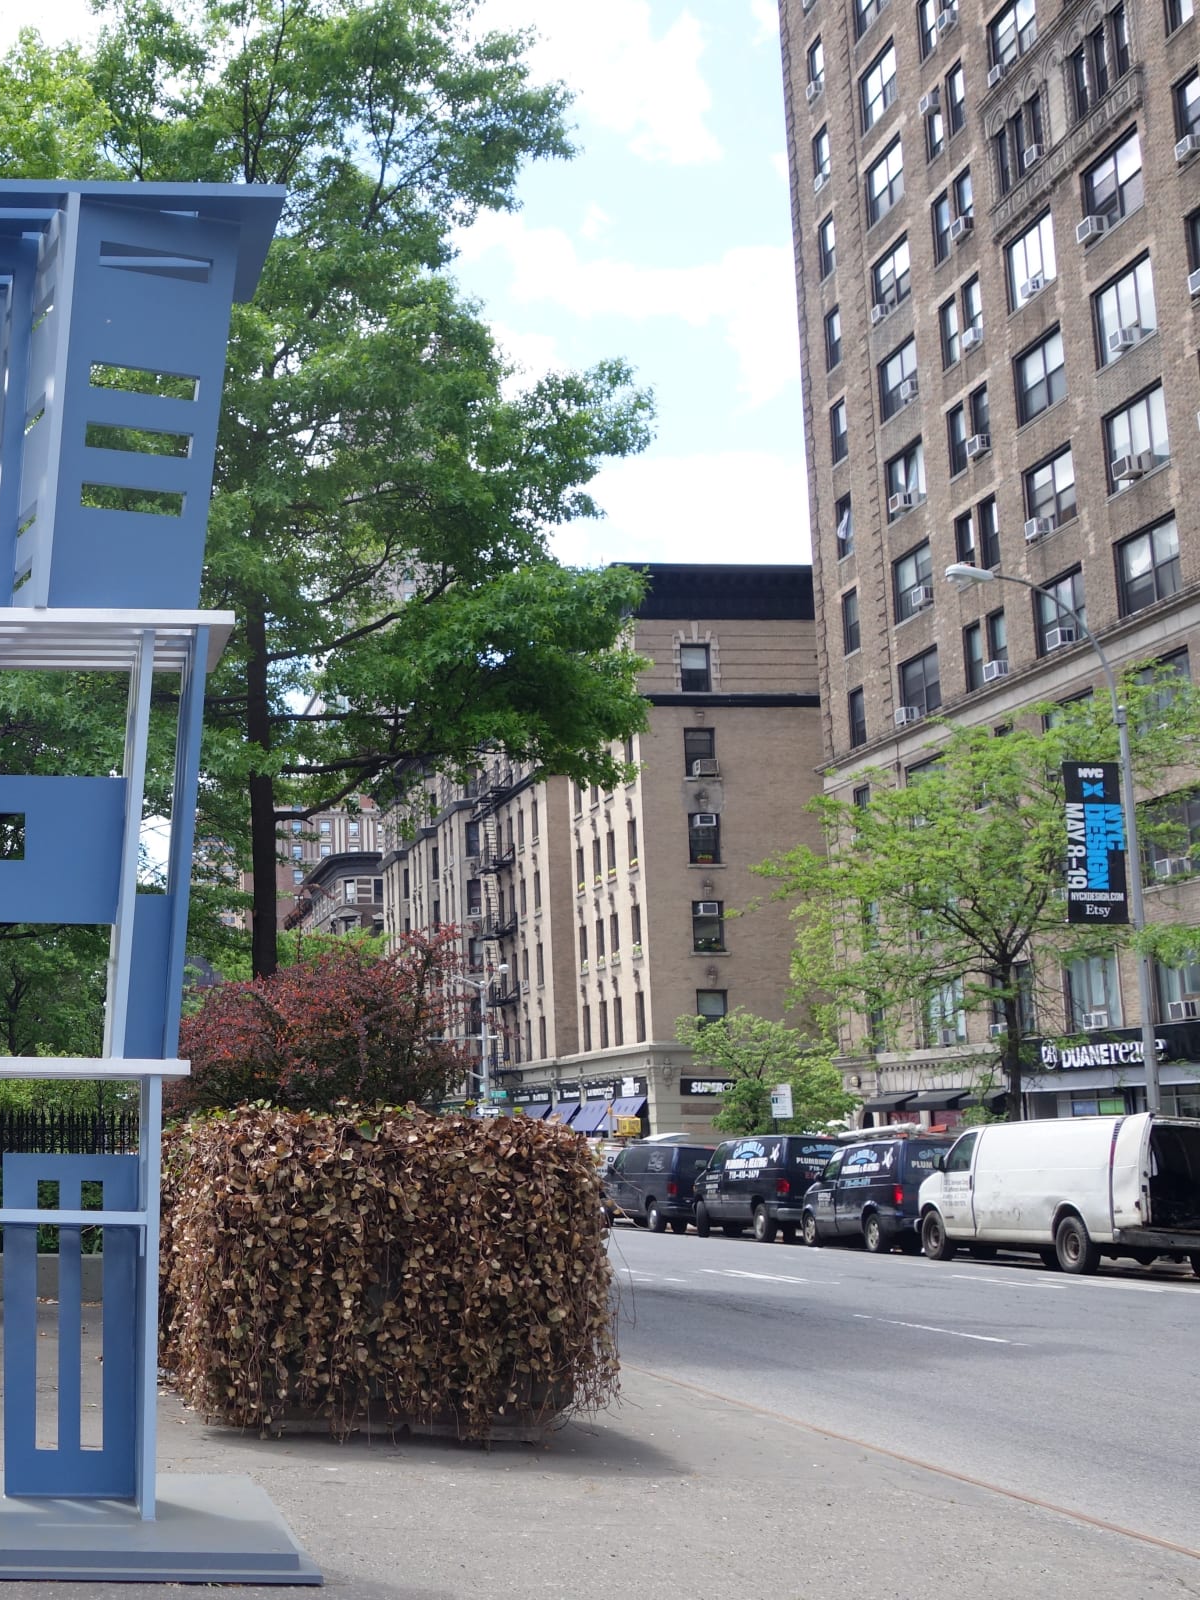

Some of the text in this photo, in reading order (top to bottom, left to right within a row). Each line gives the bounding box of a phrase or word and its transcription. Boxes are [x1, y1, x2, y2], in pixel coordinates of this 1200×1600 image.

[1078, 768, 1103, 778] NYC
[1083, 782, 1104, 798] X
[1066, 803, 1086, 841] MAY
[1104, 803, 1126, 850] NYC
[1085, 803, 1110, 889] DESIGN
[1086, 904, 1111, 917] Etsy
[1062, 1043, 1110, 1068] DUANE
